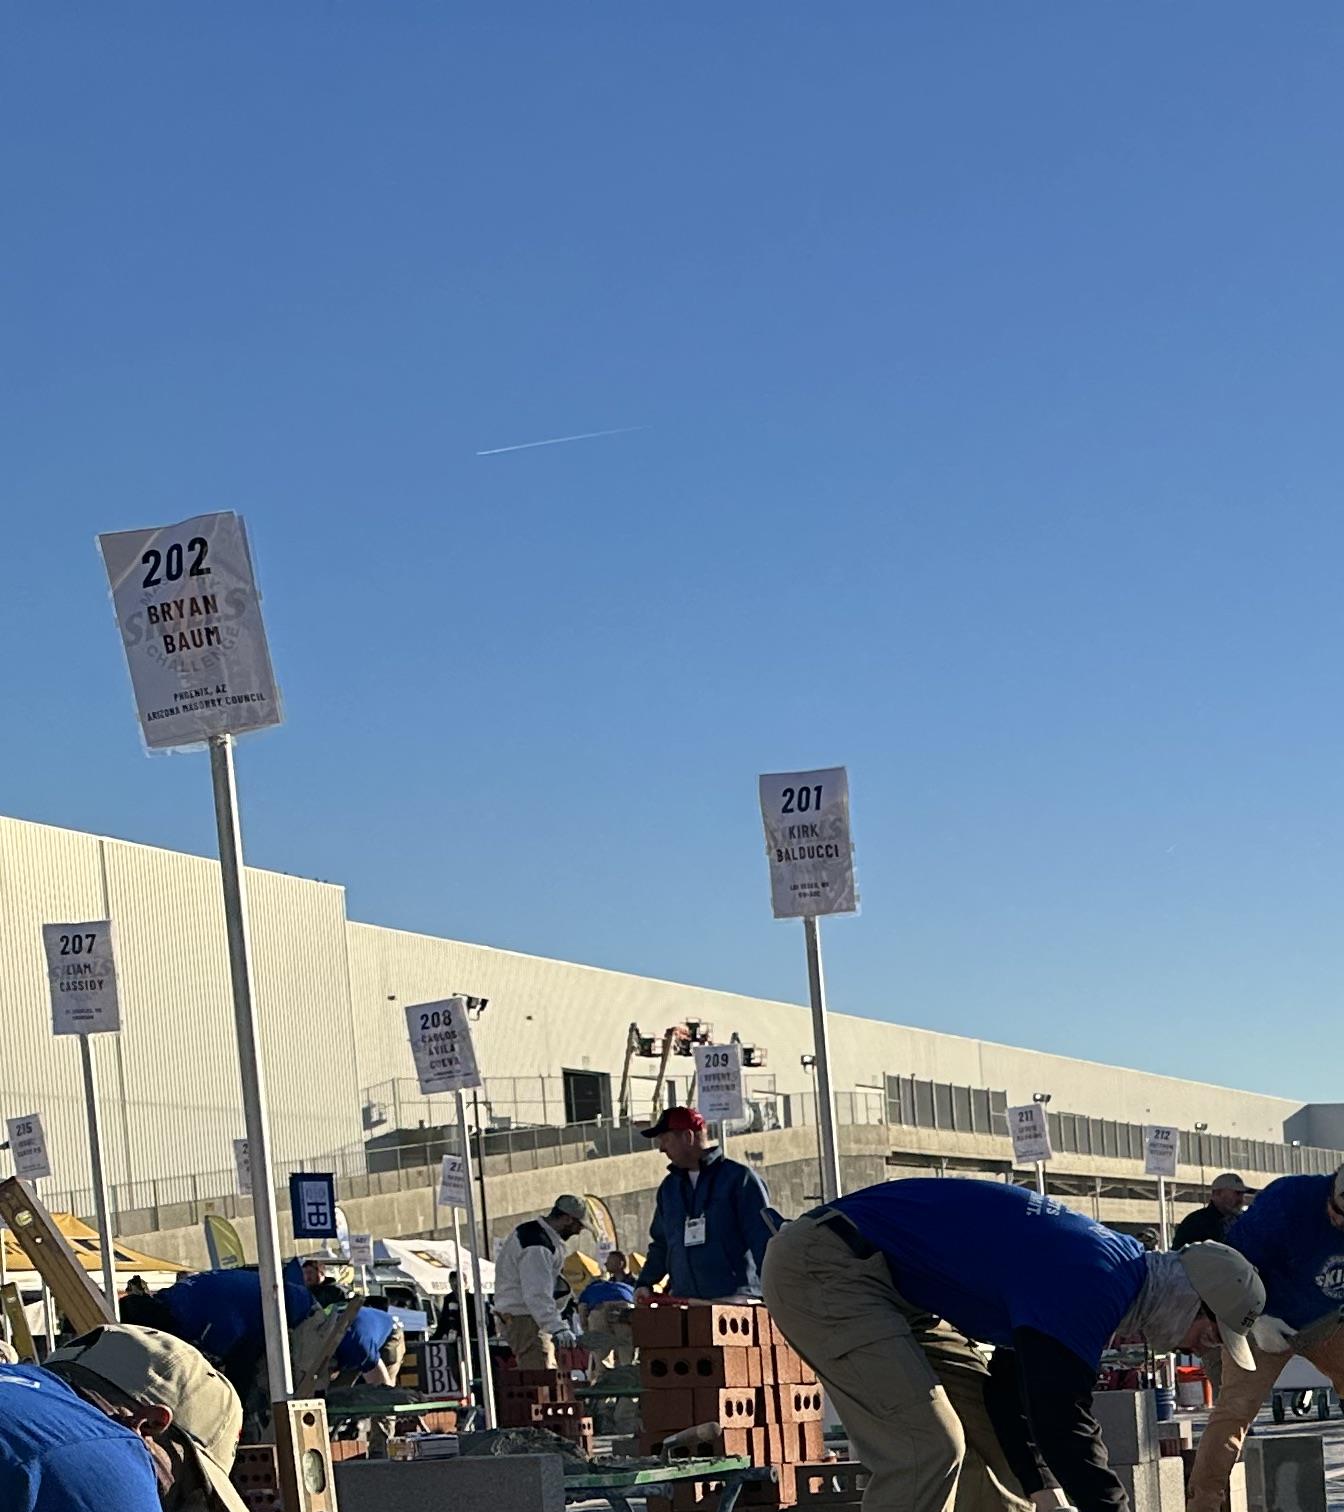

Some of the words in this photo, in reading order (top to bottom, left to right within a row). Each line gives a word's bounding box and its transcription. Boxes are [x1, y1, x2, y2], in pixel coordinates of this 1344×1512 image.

[141, 537, 211, 588] 202
[147, 594, 219, 625] BRYAN
[163, 626, 222, 654] BAUM
[225, 692, 266, 706] COUNCIL
[781, 785, 823, 814] 201
[788, 824, 819, 840] KIRK
[776, 844, 839, 863] BALDUCCI
[60, 934, 96, 955] 207
[66, 963, 91, 976] LIAM
[60, 980, 104, 992] CASSIDY
[420, 1010, 452, 1030] 208
[705, 1053, 729, 1068] 209
